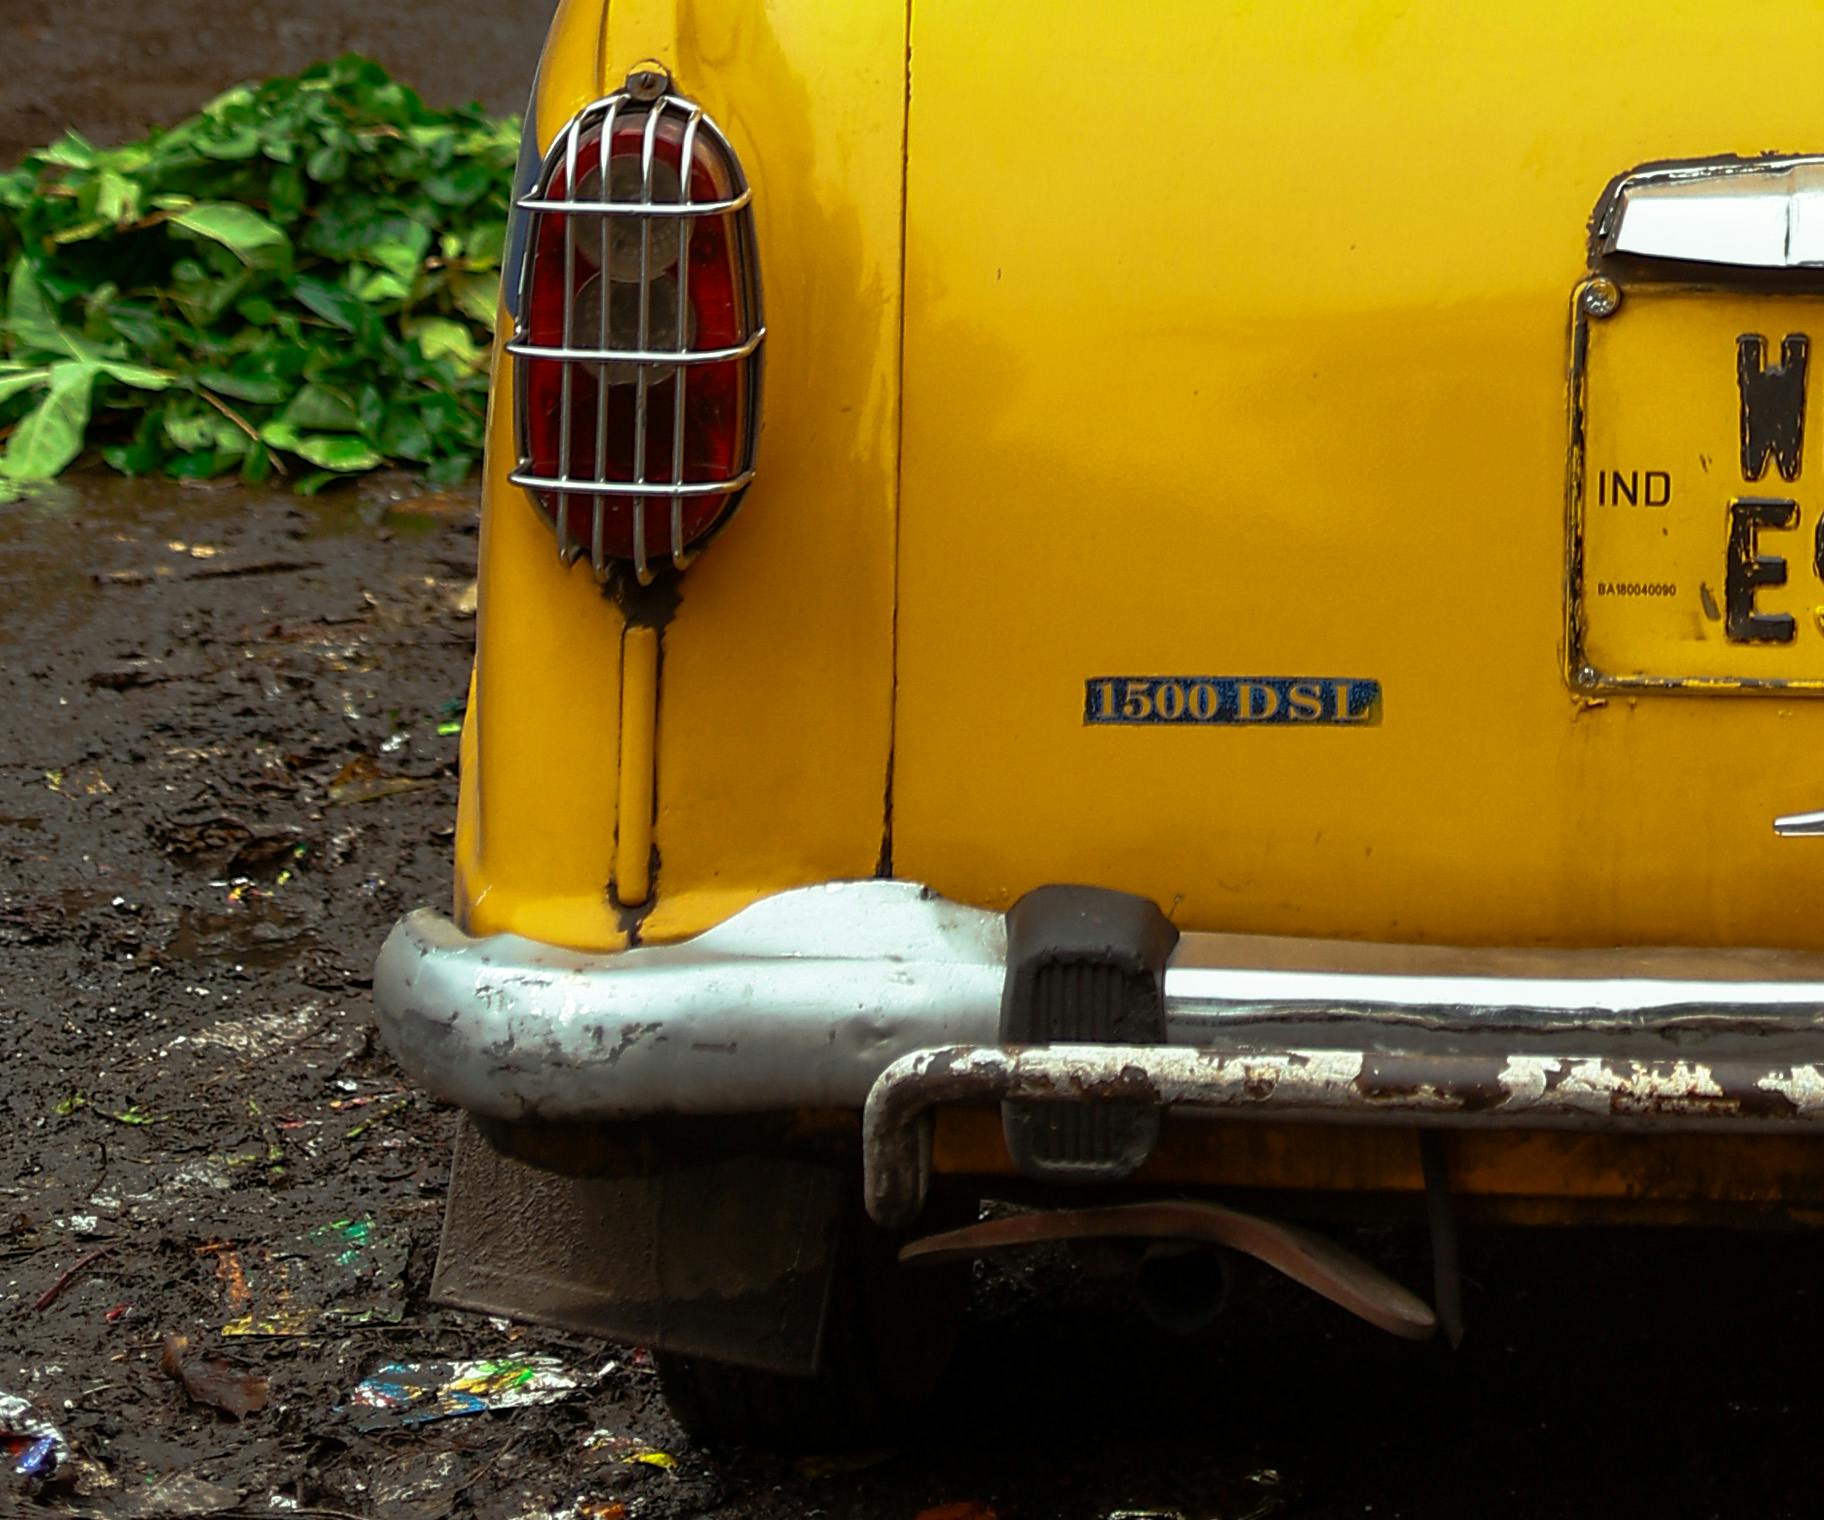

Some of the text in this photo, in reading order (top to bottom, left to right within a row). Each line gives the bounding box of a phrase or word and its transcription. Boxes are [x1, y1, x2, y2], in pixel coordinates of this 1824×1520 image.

[1598, 469, 1671, 508] IND
[1097, 681, 1371, 723] 1500 DSL
